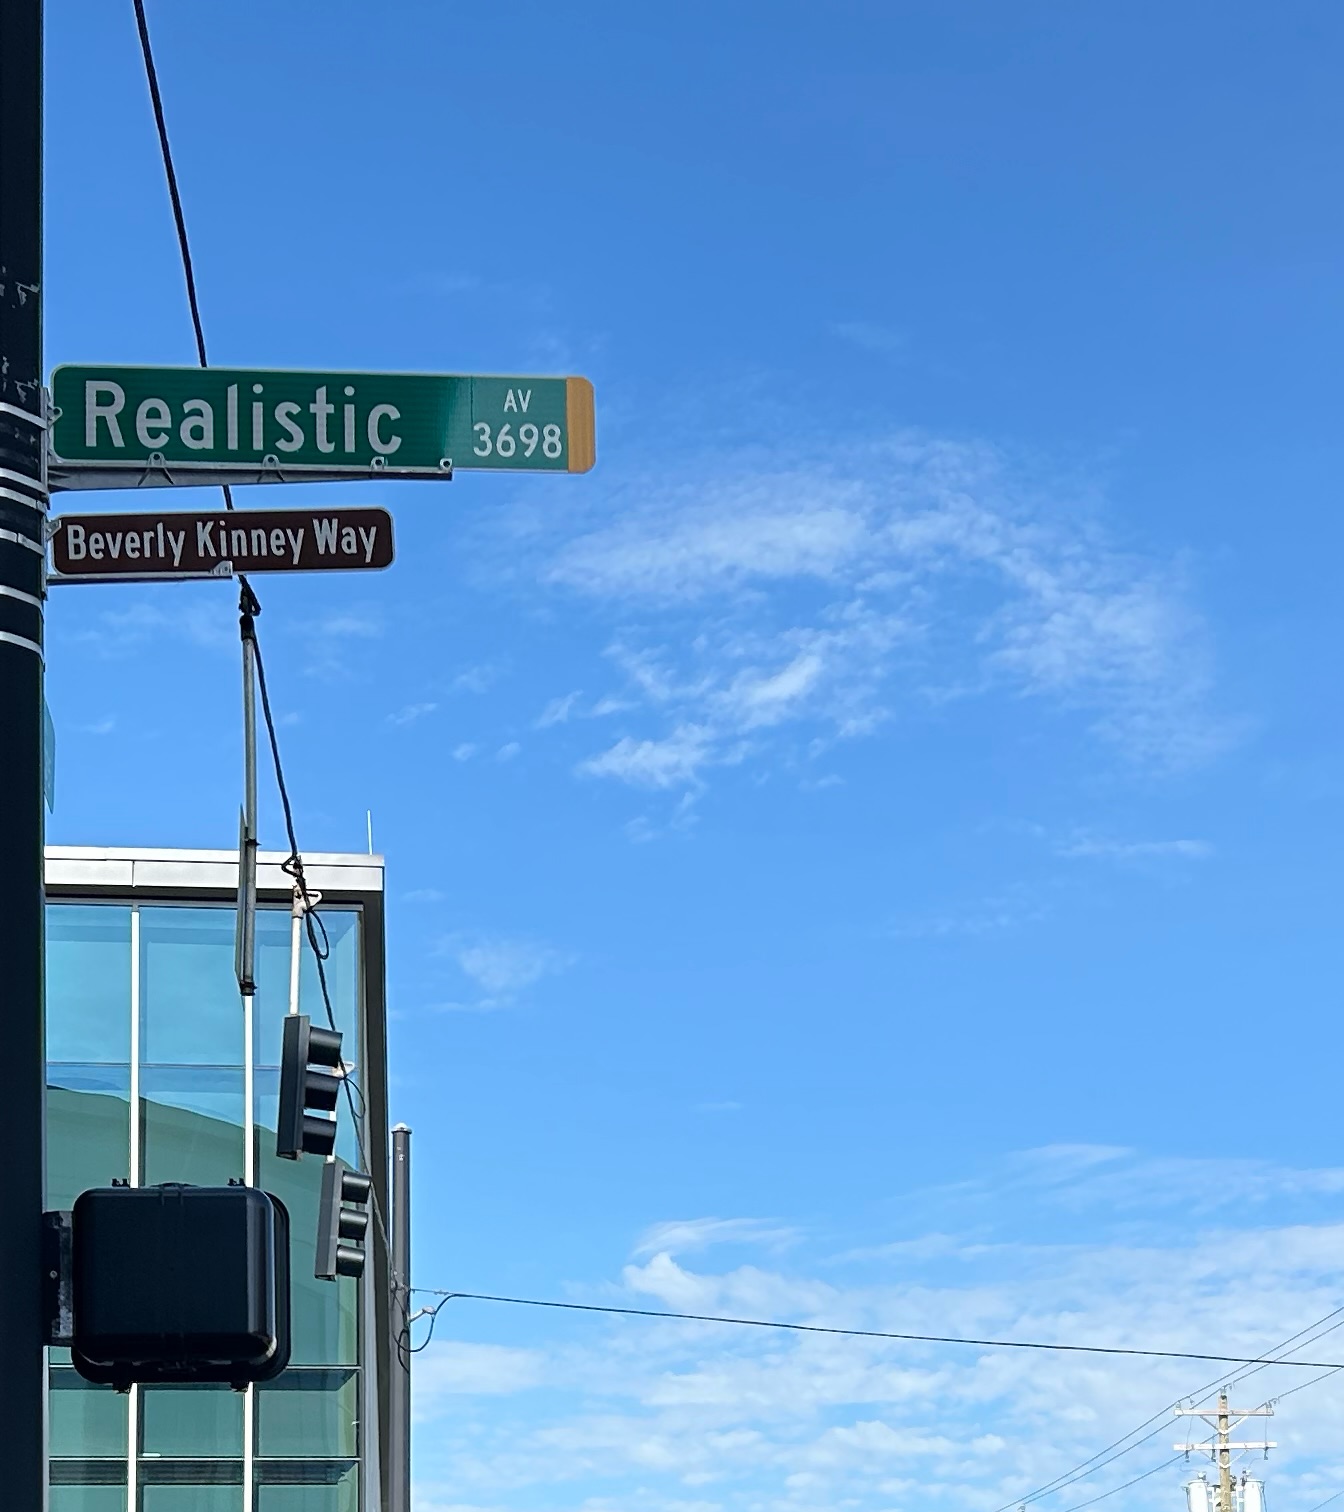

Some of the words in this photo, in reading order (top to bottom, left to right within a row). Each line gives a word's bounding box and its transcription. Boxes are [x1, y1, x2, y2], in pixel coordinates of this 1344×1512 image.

[86, 380, 403, 453] Realistic
[502, 389, 532, 413] AV
[472, 423, 562, 458] 3698
[67, 523, 184, 567] Beverly
[196, 520, 304, 564] Kinney
[313, 517, 377, 563] Way
